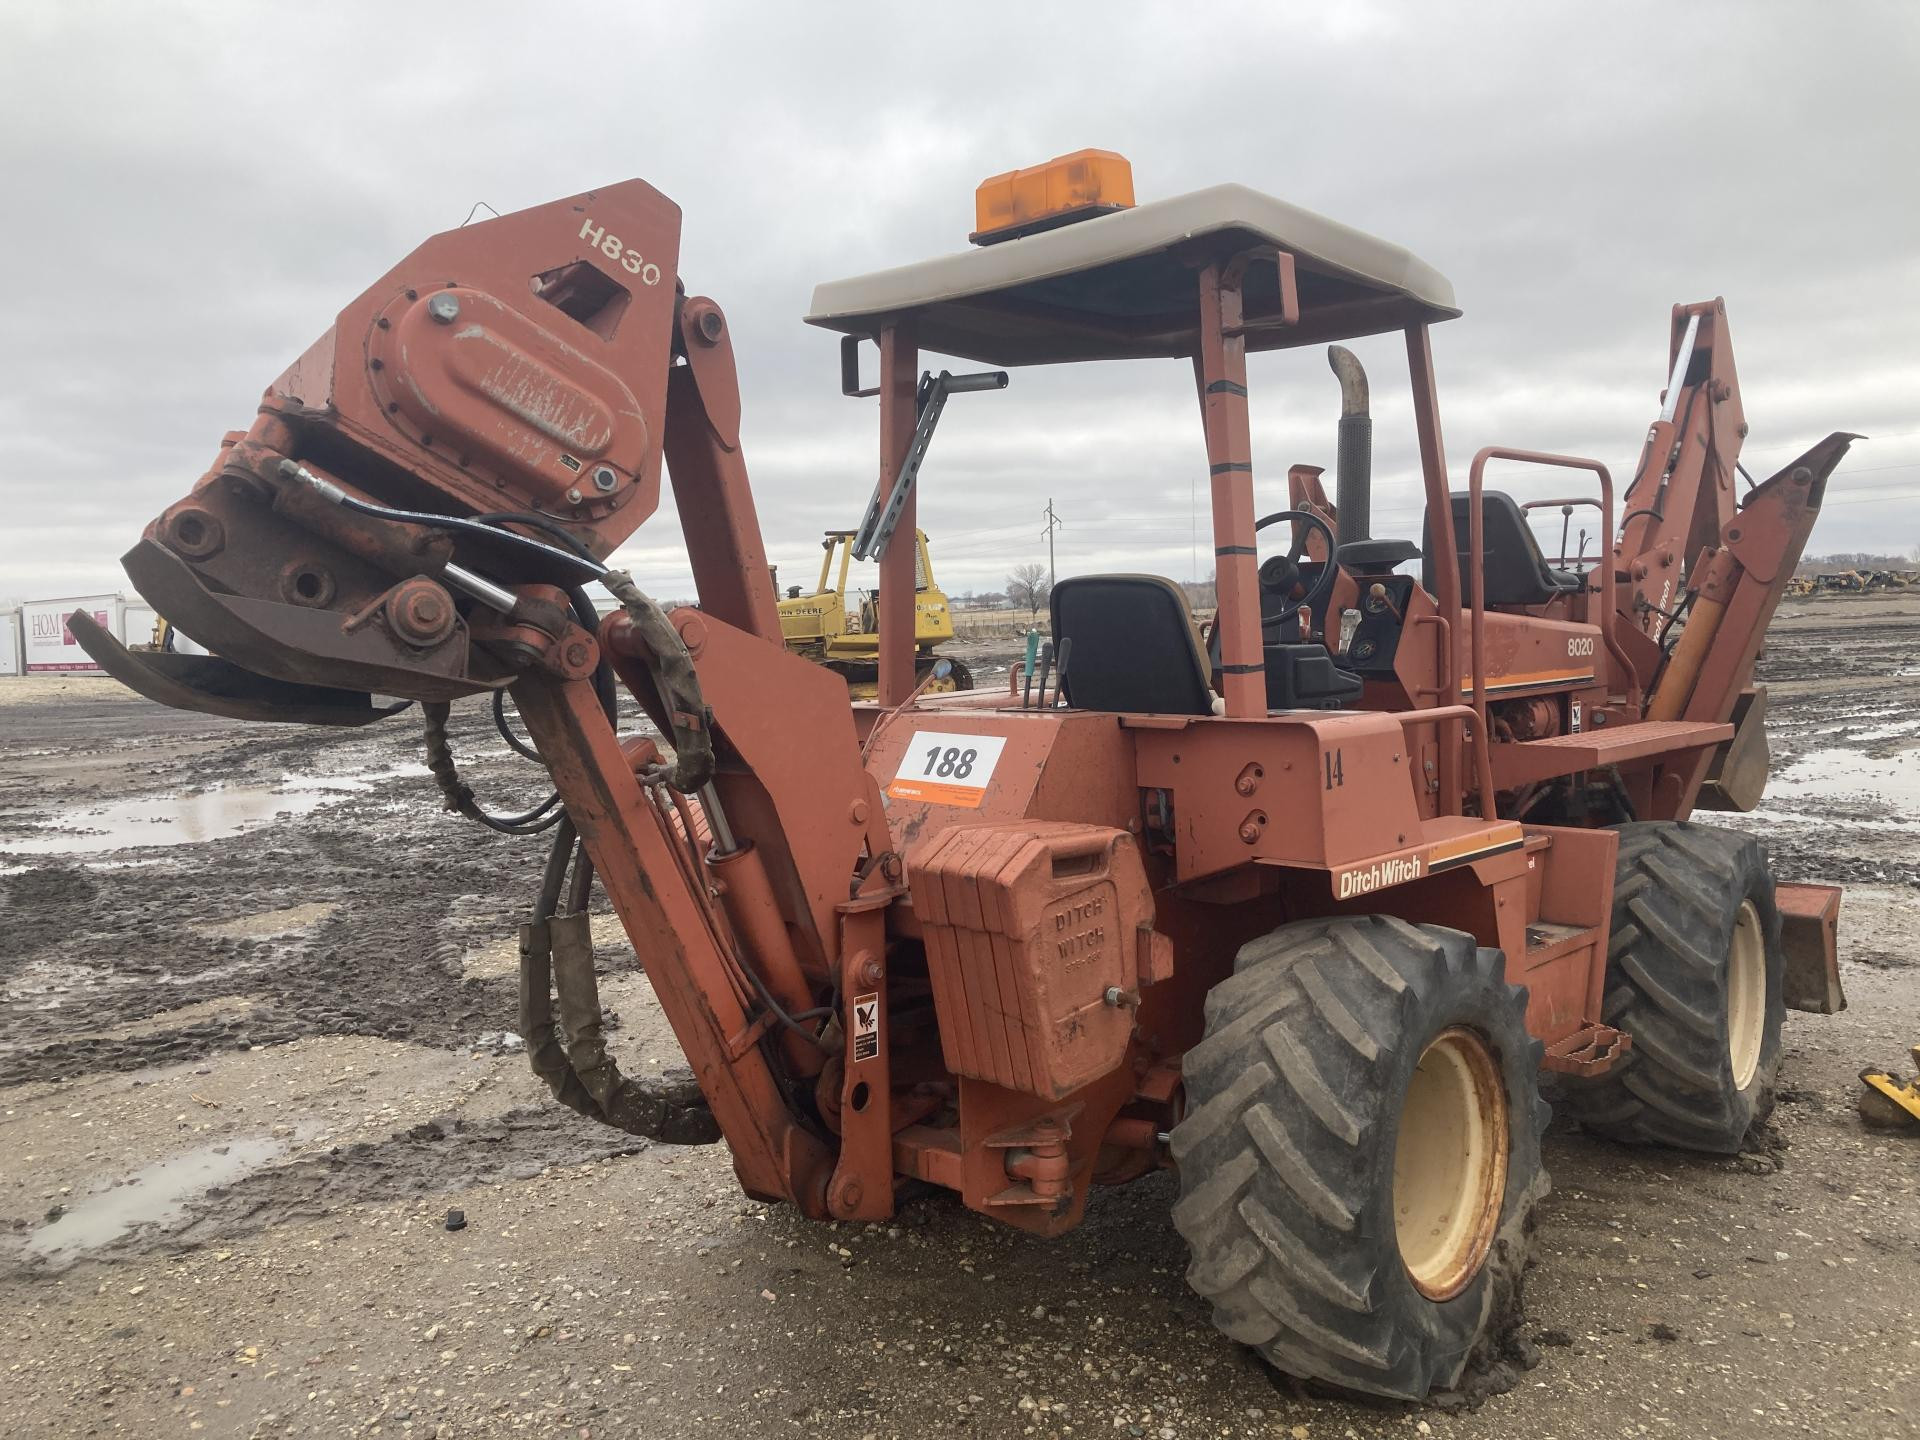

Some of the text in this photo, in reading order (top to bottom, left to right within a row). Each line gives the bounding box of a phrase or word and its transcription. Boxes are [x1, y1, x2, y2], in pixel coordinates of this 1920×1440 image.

[579, 218, 660, 286] H830
[796, 607, 823, 615] DEERE
[1567, 637, 1594, 657] 8020
[923, 746, 978, 779] 188
[1325, 747, 1344, 790] 14
[1340, 855, 1421, 898] Ditch Witch
[1055, 897, 1104, 931] DITCH
[1057, 925, 1104, 959] WITCH
